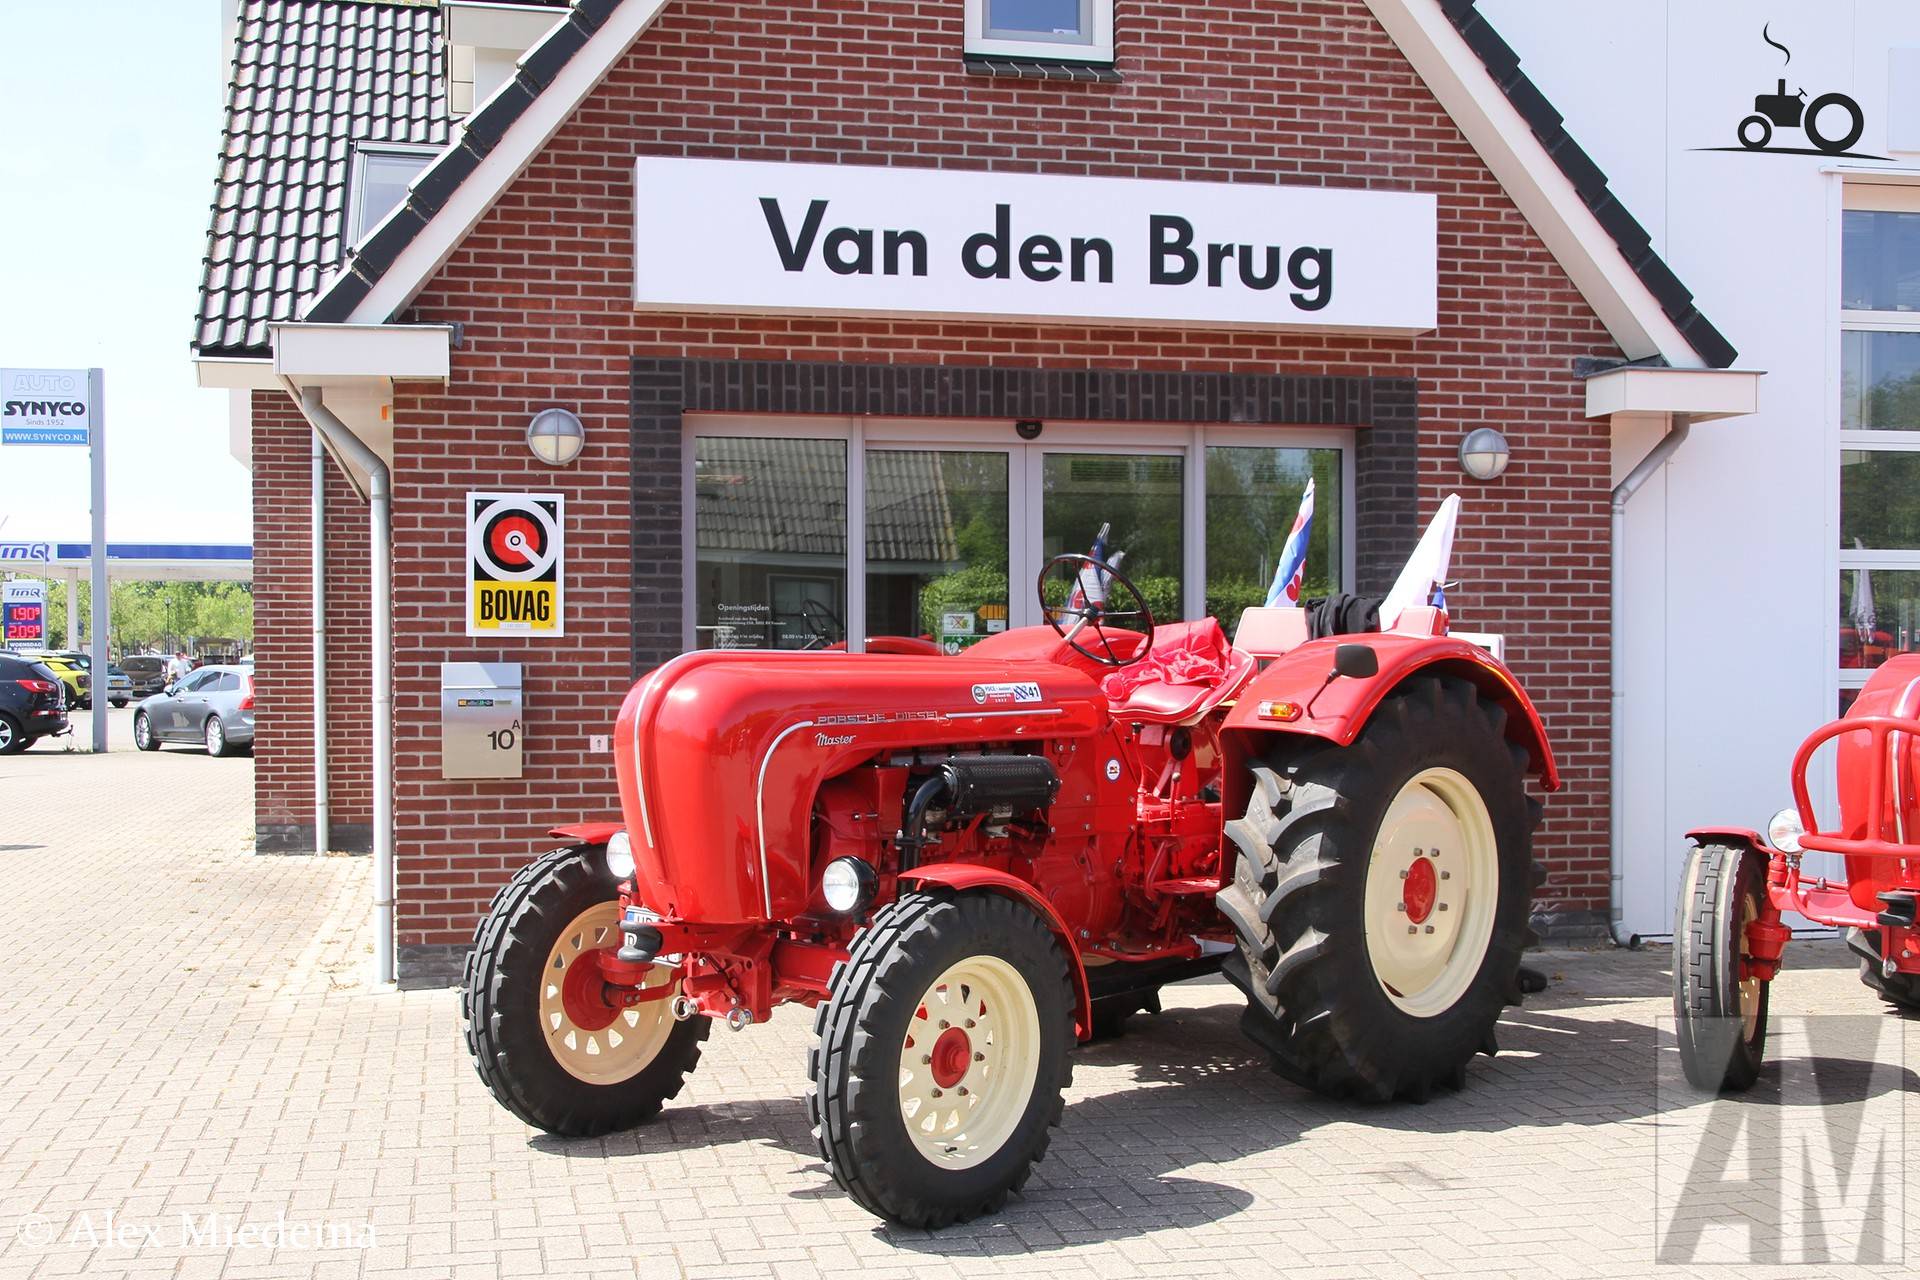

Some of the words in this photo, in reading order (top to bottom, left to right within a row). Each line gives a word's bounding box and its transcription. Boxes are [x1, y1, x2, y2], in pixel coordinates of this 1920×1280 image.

[758, 196, 929, 276] Van
[961, 203, 1114, 284] den
[1149, 213, 1334, 312] Brug
[14, 374, 75, 392] AUTO
[4, 400, 86, 417] SYNYCO
[25, 418, 44, 426] Sinds
[47, 418, 65, 426] 1952
[5, 433, 86, 441] WWW.SYNYCO.NL
[480, 589, 550, 622] BOVAG
[717, 603, 770, 612] Openingstijden
[1028, 686, 1039, 697] 41
[817, 712, 886, 725] PORSCHE
[895, 710, 938, 721] DIESEL
[814, 732, 857, 746] Master
